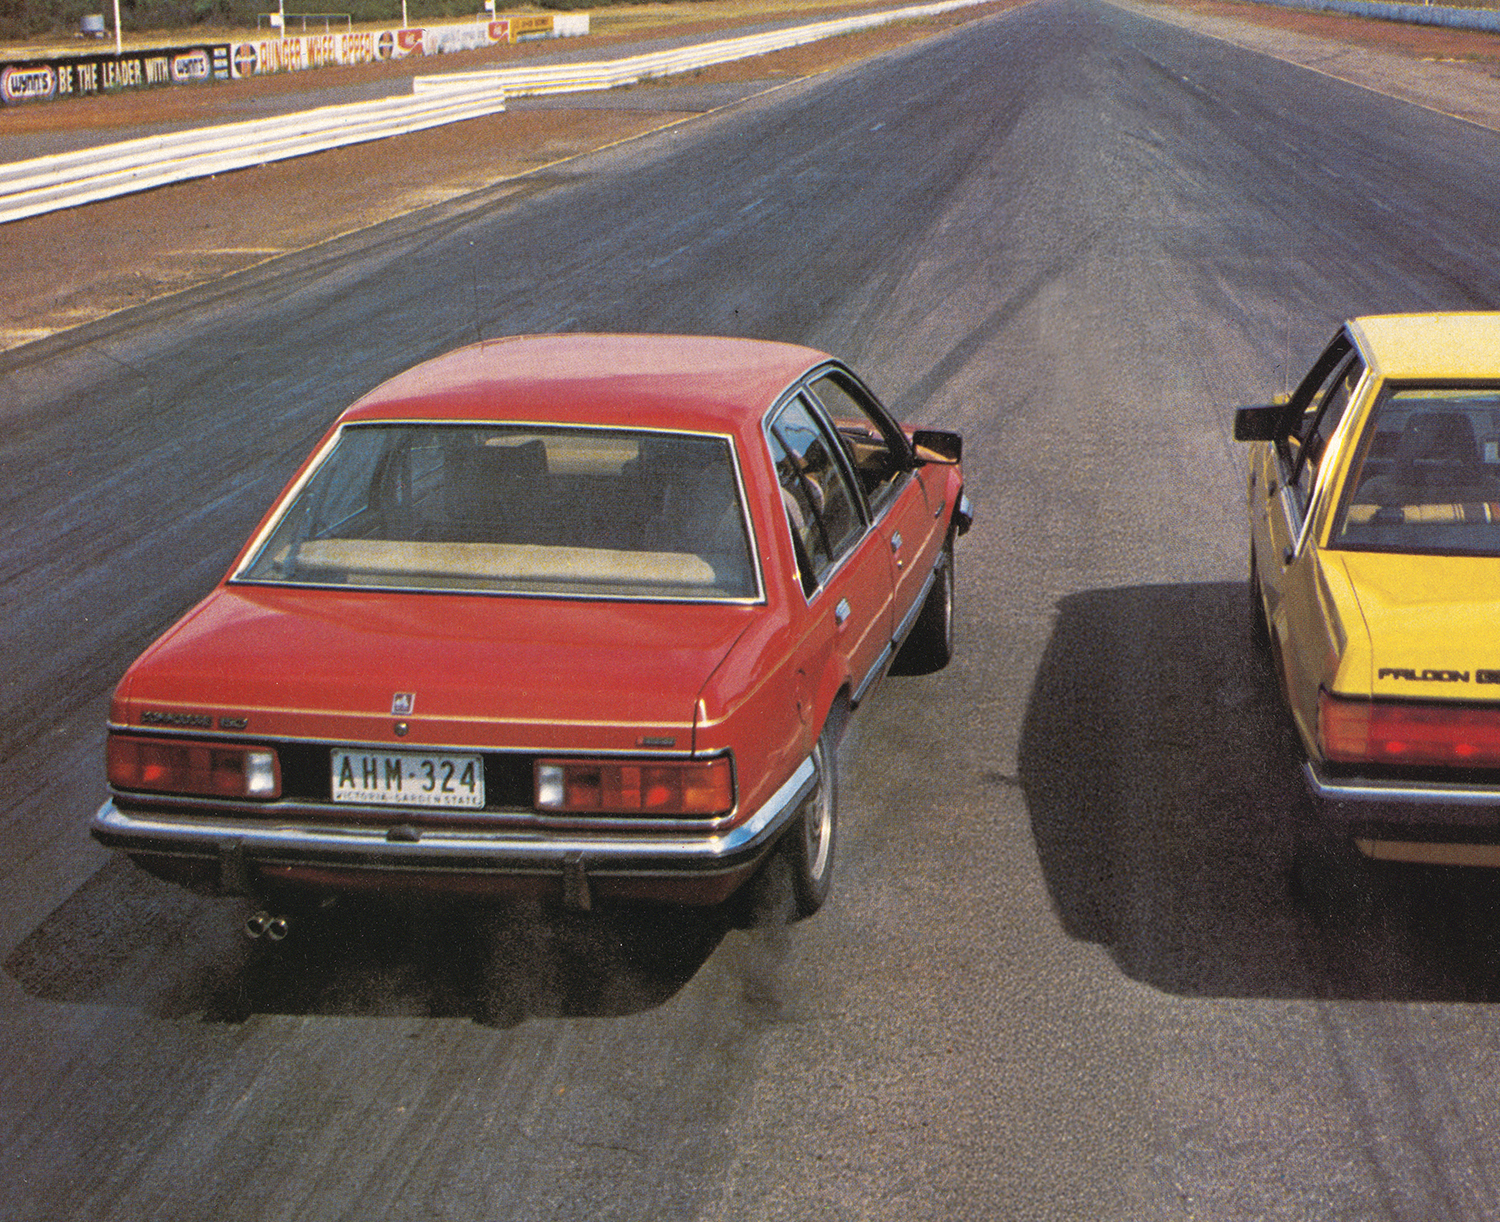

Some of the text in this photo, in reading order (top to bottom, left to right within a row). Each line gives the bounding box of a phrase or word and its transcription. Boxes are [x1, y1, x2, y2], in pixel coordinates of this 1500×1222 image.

[58, 66, 73, 94] BE
[77, 63, 98, 91] THE
[102, 59, 142, 88] LEADER
[145, 57, 169, 84] WITH
